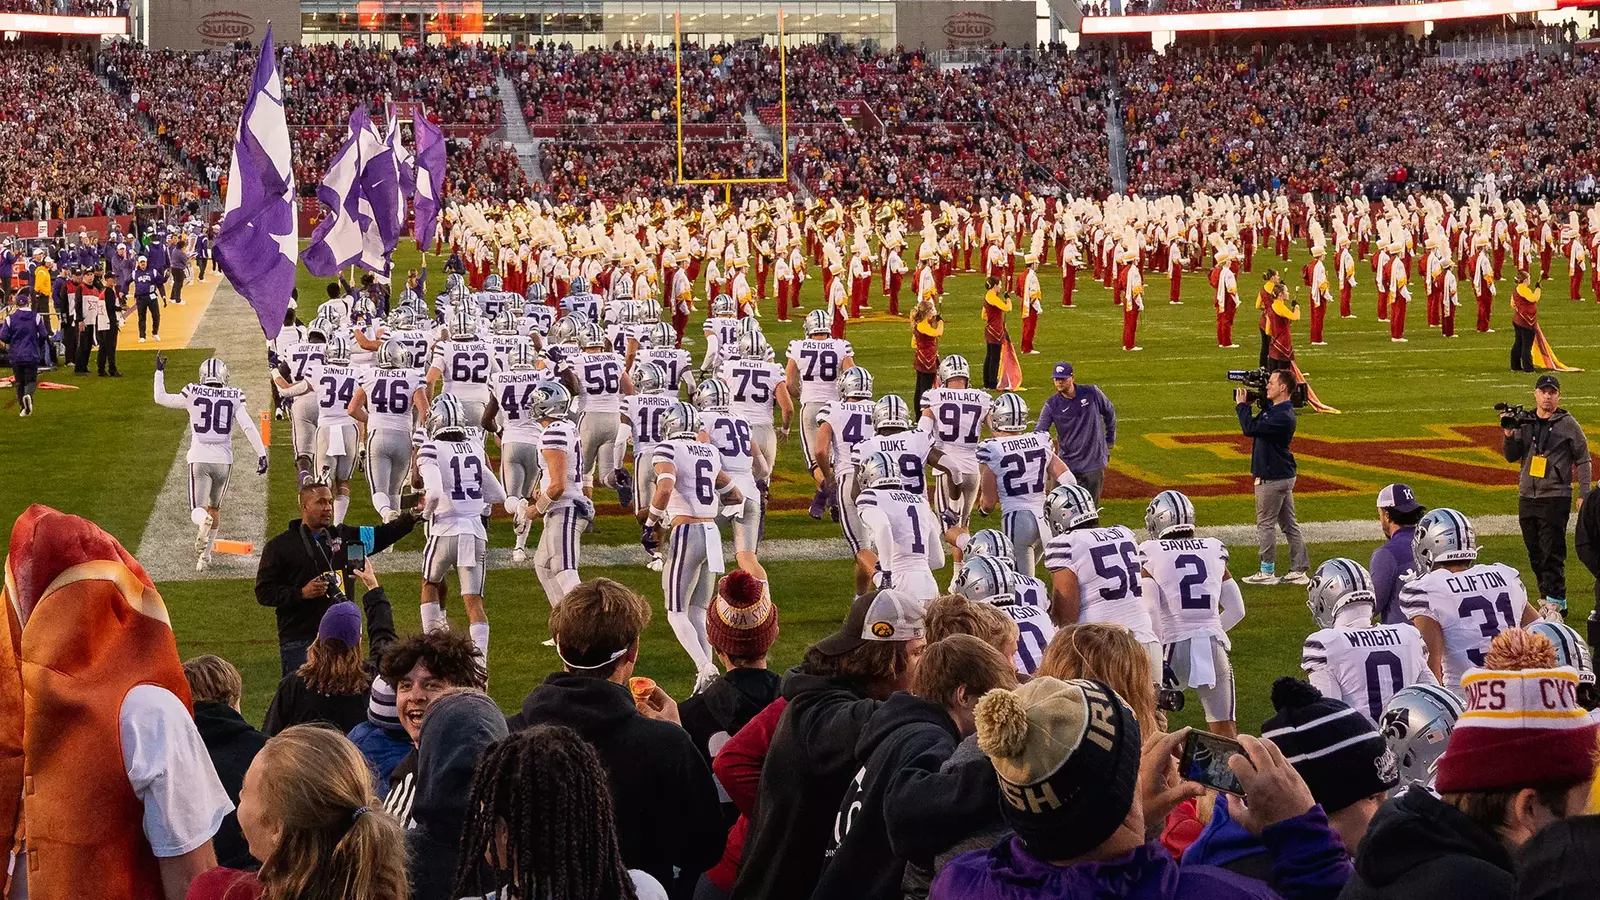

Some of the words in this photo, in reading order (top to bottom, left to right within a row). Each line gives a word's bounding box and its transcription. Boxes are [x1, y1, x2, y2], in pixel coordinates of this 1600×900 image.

[202, 20, 249, 37] Sukup
[947, 21, 991, 37] Sukup
[403, 332, 424, 340] ALLEN
[803, 341, 835, 350] PASTORE
[584, 355, 616, 364] LEINGANG
[649, 351, 678, 359] GIDDENS
[323, 366, 354, 377] SINNOTT
[452, 353, 488, 383] 62
[740, 361, 763, 369] HECHT
[800, 350, 838, 381] 78
[374, 370, 407, 379] FRIESEN
[498, 372, 541, 383] OSUNSANMI
[584, 362, 618, 395] 56
[191, 386, 239, 399] MASCHMEIER
[319, 376, 355, 409] 34
[733, 369, 770, 403] 75
[371, 379, 410, 414] 46
[638, 397, 670, 407] PARRISH
[939, 391, 981, 403] MATLACK
[194, 397, 233, 435] 30
[939, 403, 983, 444] 97
[715, 418, 753, 458] 38
[880, 439, 908, 451] DUKE
[1001, 437, 1040, 453] FORSHA
[451, 443, 474, 454] LOYD
[686, 445, 714, 458] MARSH
[450, 456, 483, 500] 13
[1000, 448, 1047, 497] 27
[695, 459, 714, 506] 6
[1403, 489, 1414, 499] K
[906, 505, 926, 554] 1
[1160, 539, 1208, 552] SAVAGE
[1446, 552, 1477, 560] WILDCATS
[1174, 554, 1211, 610] 2
[1446, 571, 1507, 593] CLIFTON
[1459, 592, 1517, 667] 31
[1344, 628, 1402, 648] WRIGHT
[1365, 650, 1404, 723] 0
